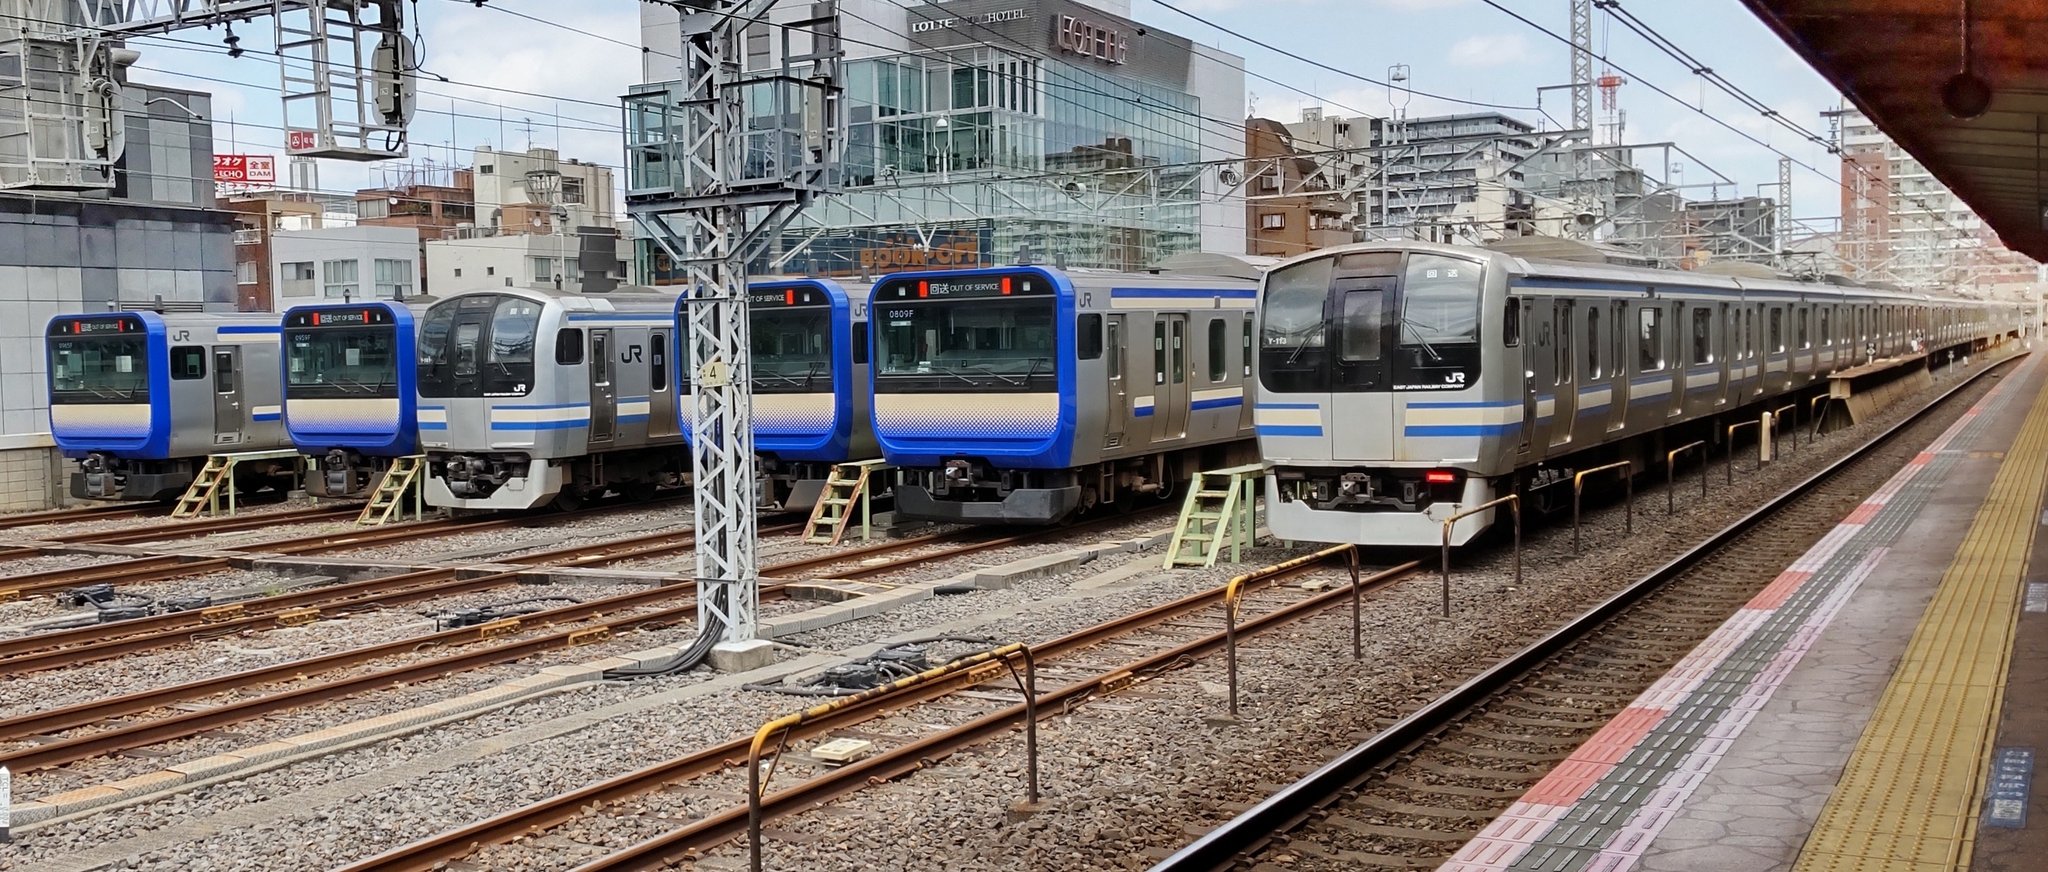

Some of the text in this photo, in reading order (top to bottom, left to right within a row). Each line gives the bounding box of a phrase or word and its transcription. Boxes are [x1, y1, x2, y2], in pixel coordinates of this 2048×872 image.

[912, 18, 954, 33] LOTTE
[986, 8, 1028, 23] HOTEL
[929, 282, 1000, 295] 回送 OUT OF SERVICE
[763, 294, 785, 302] SERVICE
[1079, 292, 1093, 308] JR
[888, 309, 915, 319] 0809F
[172, 330, 191, 342] JR
[1538, 320, 1551, 347] JR
[621, 344, 643, 364] JR
[709, 366, 718, 379] 4
[1445, 371, 1466, 384] JR
[513, 383, 527, 392] JR
